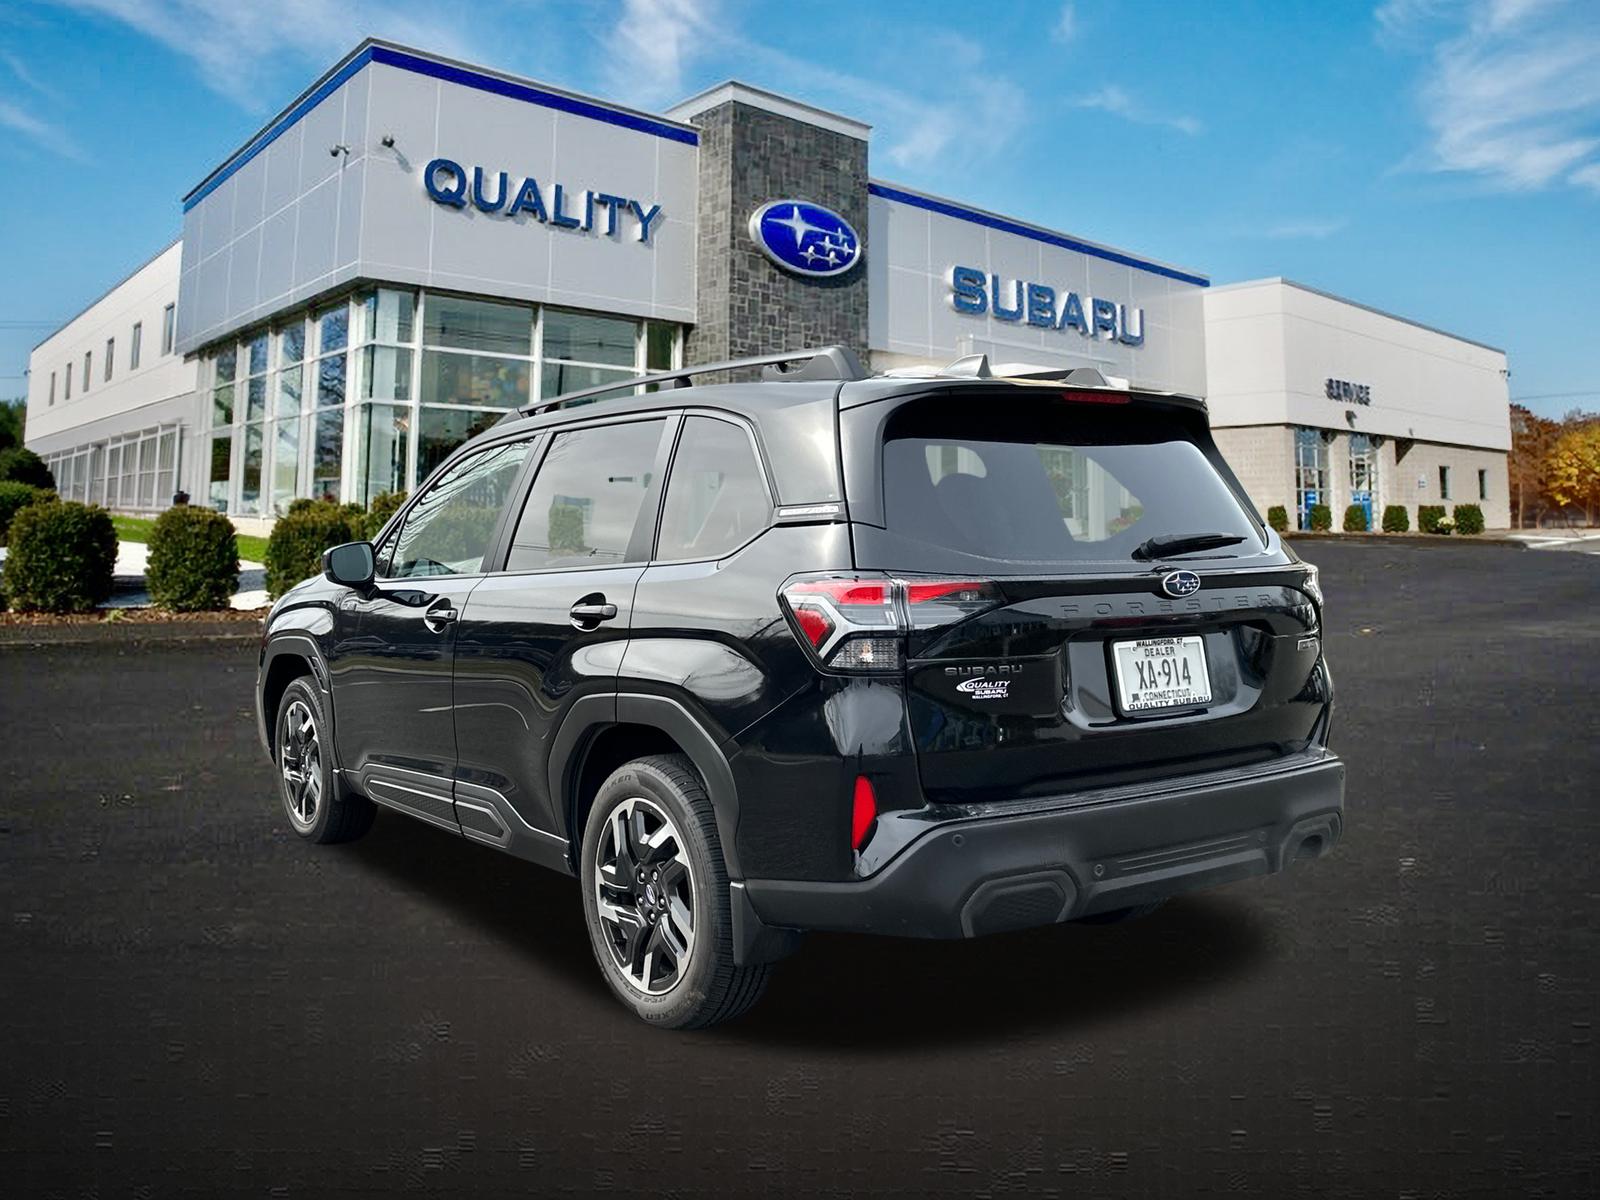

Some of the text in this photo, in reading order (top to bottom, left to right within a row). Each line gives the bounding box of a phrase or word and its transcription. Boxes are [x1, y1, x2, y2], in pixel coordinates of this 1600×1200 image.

[424, 158, 661, 243] QUALITY
[952, 264, 1145, 346] SUBARU
[1325, 378, 1371, 406] SERVICE
[1059, 594, 1273, 617] FORESTER
[1144, 646, 1175, 656] DEALER
[944, 664, 1023, 675] SUBARU
[966, 680, 1010, 689] QUALITY
[1143, 688, 1190, 700] CONNECTICUT
[1128, 695, 1210, 710] QUALITY SUBARU
